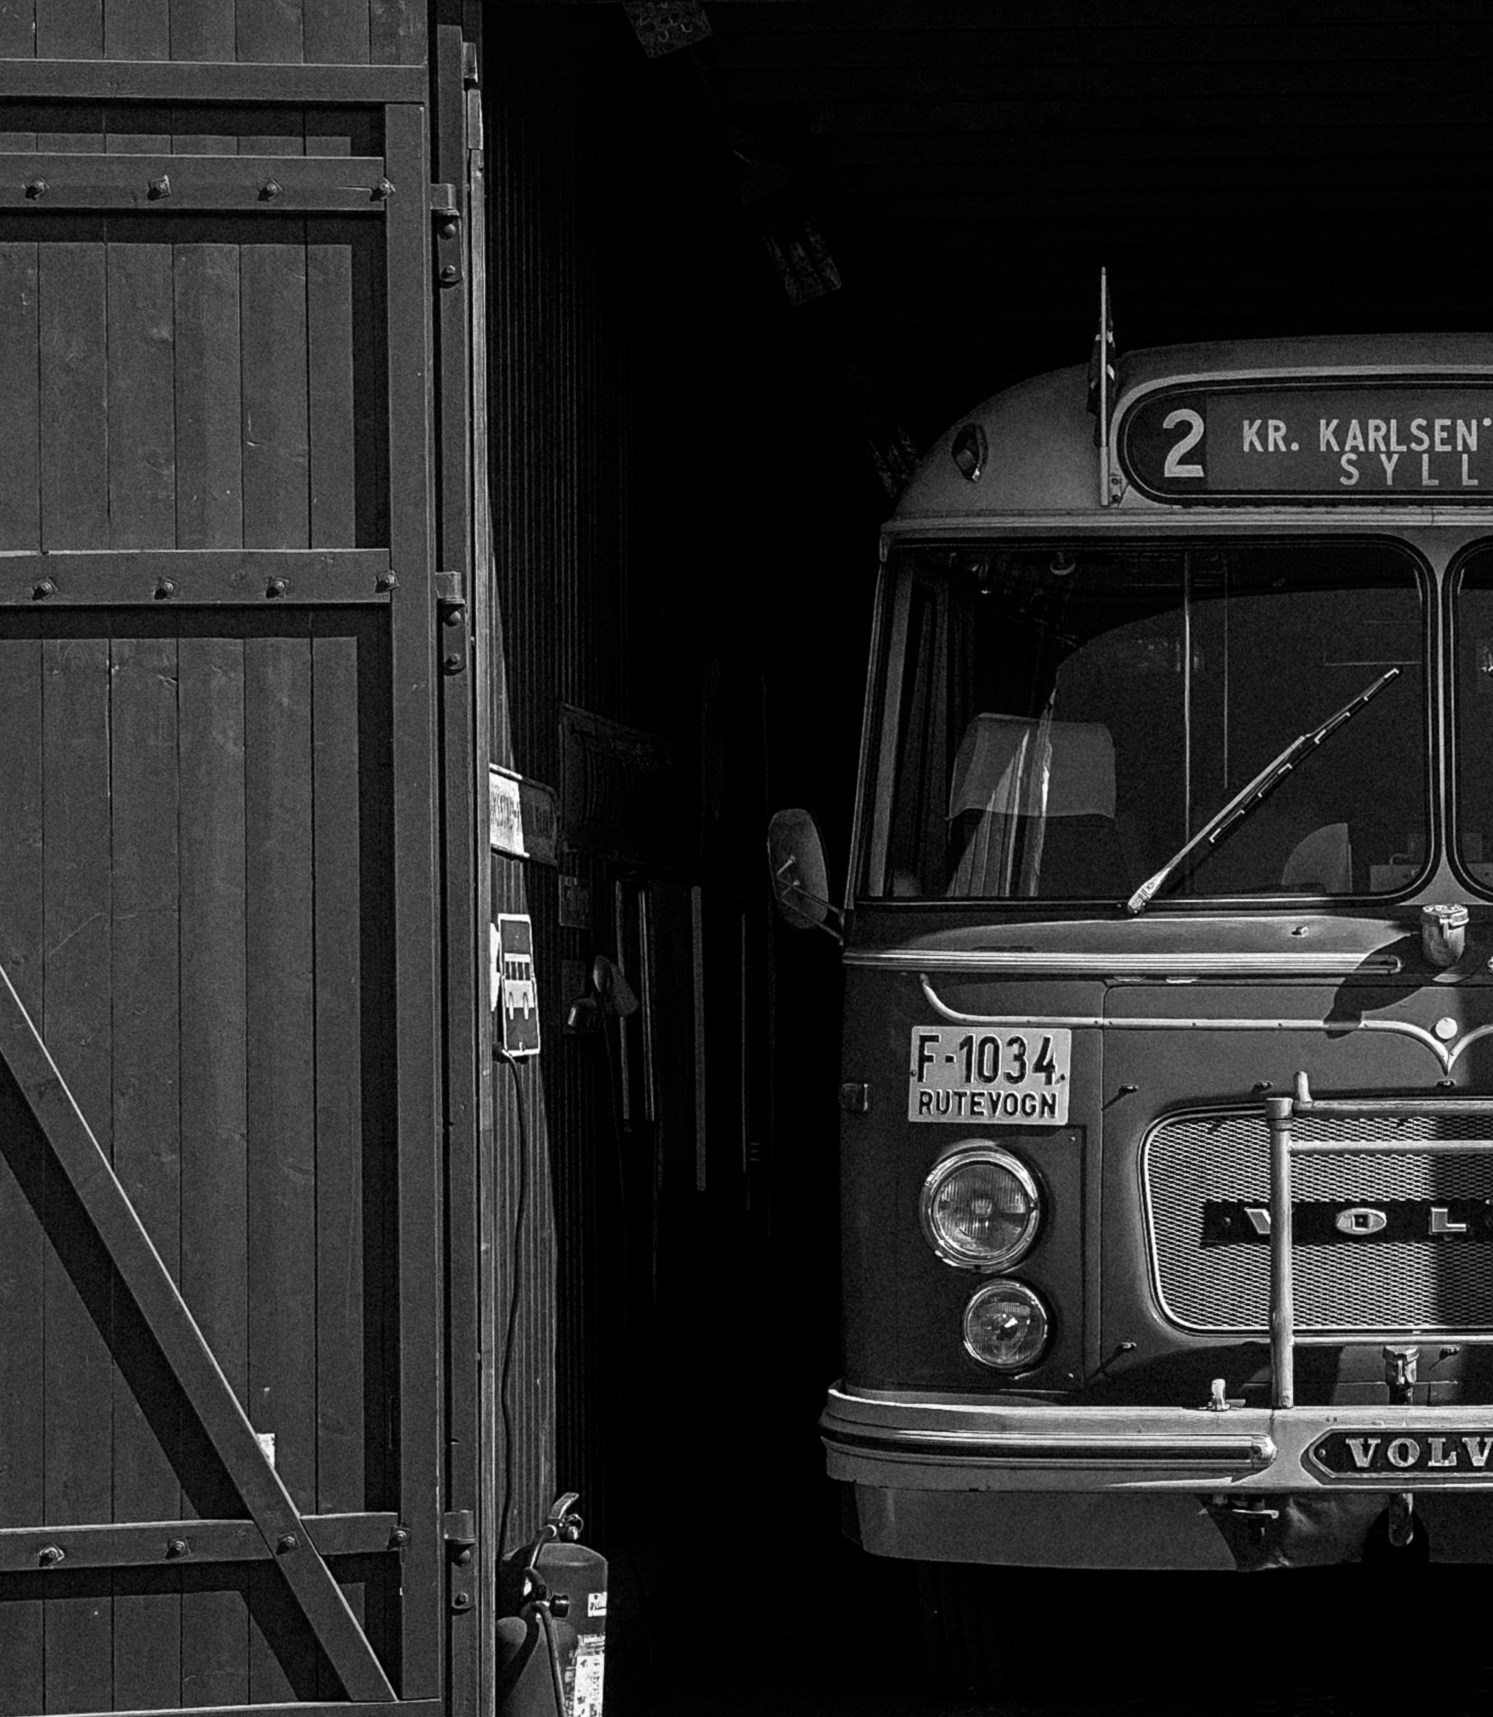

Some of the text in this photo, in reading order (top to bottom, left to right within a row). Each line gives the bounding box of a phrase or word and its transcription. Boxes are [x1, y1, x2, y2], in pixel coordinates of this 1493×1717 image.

[1162, 408, 1205, 478] 2
[1243, 418, 1300, 453] KR.
[917, 1034, 1057, 1086] F-1034
[918, 1090, 1058, 1119] RUTEVOGN
